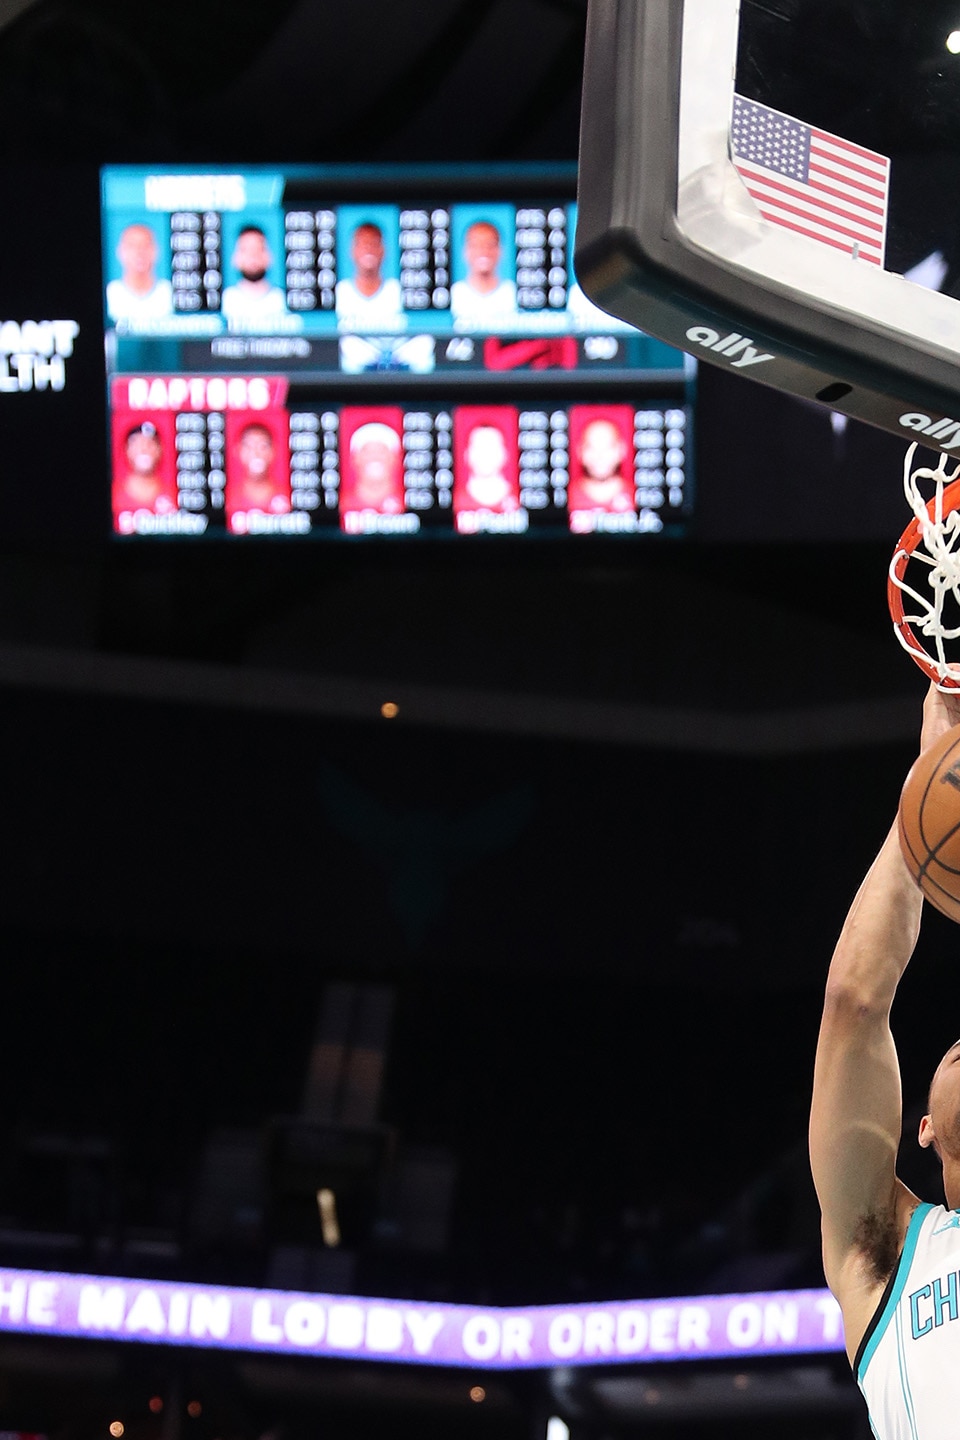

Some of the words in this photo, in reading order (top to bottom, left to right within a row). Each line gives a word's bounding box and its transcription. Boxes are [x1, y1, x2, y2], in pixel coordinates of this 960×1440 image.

[686, 326, 774, 369] ally
[77, 1284, 232, 1340] MAIN
[250, 1298, 445, 1356] LOBBY
[461, 1314, 534, 1361] OR
[547, 1302, 711, 1359] ORDER
[726, 1302, 799, 1344] ON
